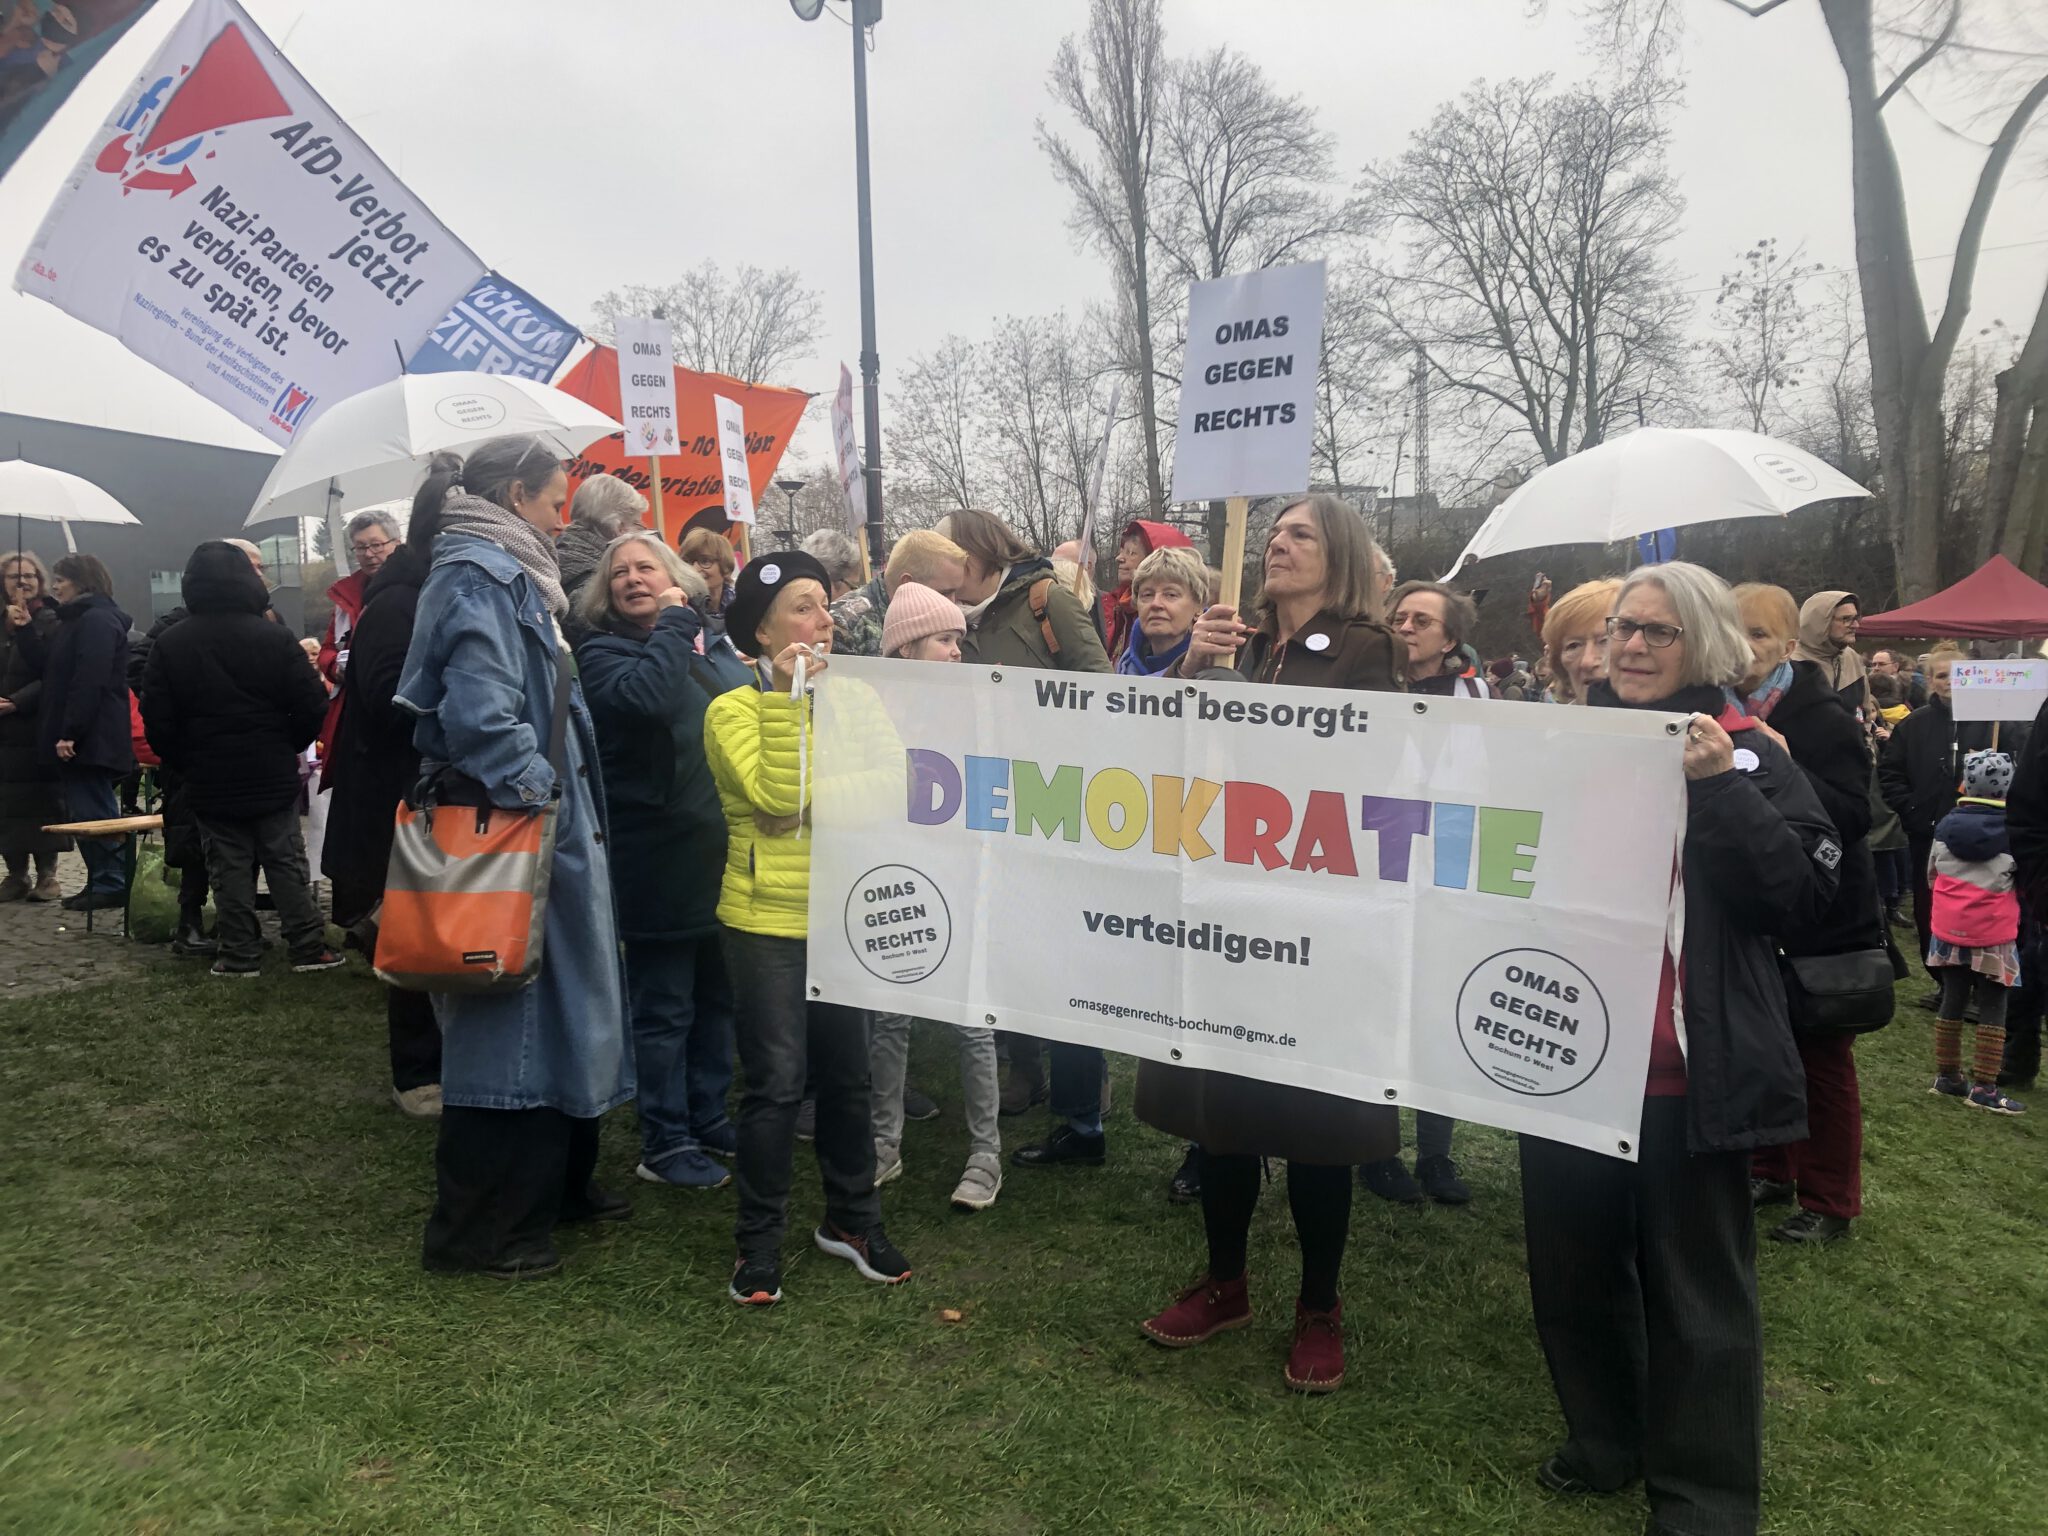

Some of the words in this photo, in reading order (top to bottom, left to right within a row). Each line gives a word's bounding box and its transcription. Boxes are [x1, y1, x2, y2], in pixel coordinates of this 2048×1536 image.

[270, 121, 429, 265] AfD-Verbot
[200, 185, 334, 303] Nazi-Parteien
[183, 220, 283, 312] verbieten,
[288, 298, 349, 355] bevor
[328, 229, 424, 306] jetzt!
[138, 236, 171, 263] es
[168, 258, 204, 289] zu
[204, 283, 257, 329] spät
[255, 315, 288, 356] ist.
[133, 292, 179, 329] Naziregimes
[184, 327, 207, 346] Bund
[204, 341, 220, 355] der
[218, 351, 277, 396] Antifaschistinnen
[181, 306, 224, 342] Vereinigung
[223, 337, 237, 350] der
[236, 345, 271, 378] Verfolgten
[270, 366, 286, 385] des
[633, 342, 661, 356] OMAS
[1215, 315, 1289, 345] OMAS
[206, 360, 221, 375] und
[220, 370, 270, 407] Antifaschisten
[632, 374, 666, 387] GEGEN
[1204, 354, 1294, 386] GEGEN
[630, 405, 671, 419] RECHTS
[1194, 402, 1296, 434] RECHTS
[690, 435, 716, 457] no
[1034, 679, 1095, 711] Wir
[1105, 686, 1184, 718] sind
[1198, 691, 1369, 738] besorgt:
[906, 748, 1544, 899] DEMOKRATIE
[863, 881, 916, 903] OMAS
[864, 904, 927, 928] GEGEN
[1082, 910, 1311, 966] verteidigen!
[865, 928, 937, 953] RECHTS
[1505, 965, 1580, 1004] OMAS
[1069, 998, 1297, 1047] omasgegenrechts-bochum@gmx.de
[1489, 991, 1580, 1036] GEGEN
[1474, 1015, 1578, 1066] RECHTS
[1488, 1042, 1522, 1060] Bochum
[1533, 1058, 1554, 1072] West
